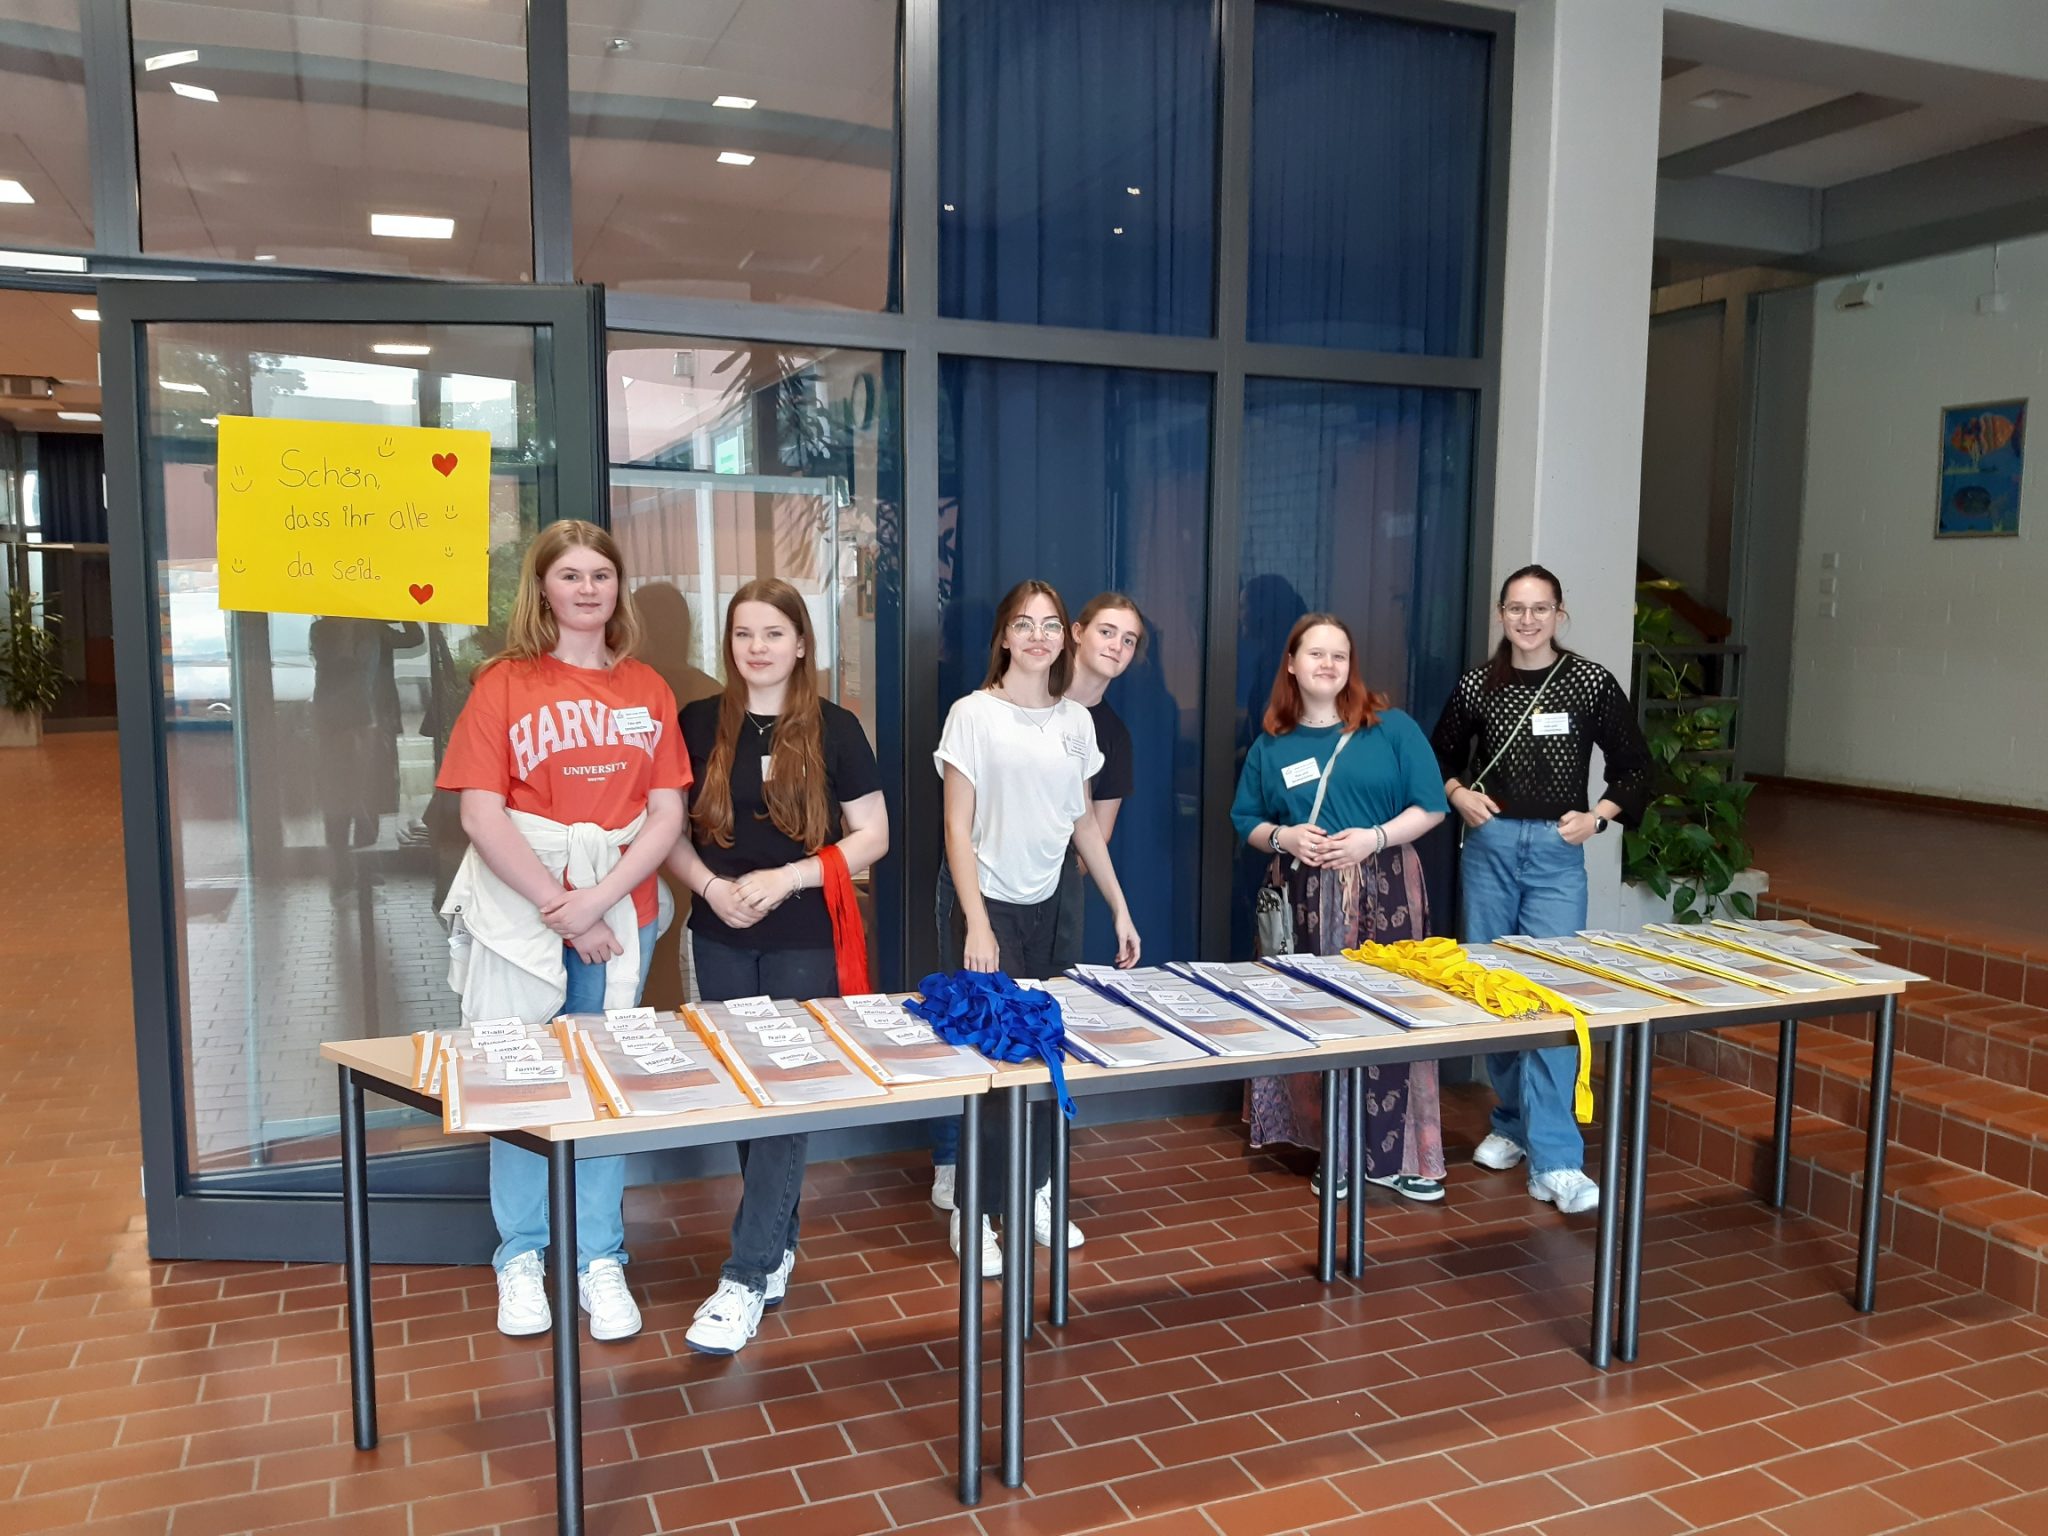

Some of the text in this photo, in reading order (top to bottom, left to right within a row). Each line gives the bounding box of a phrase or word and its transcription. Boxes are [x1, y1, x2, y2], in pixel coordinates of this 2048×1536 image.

[278, 449, 380, 490] Schön,
[284, 502, 429, 531] dass ihr alle
[287, 551, 381, 581] da seid.
[562, 761, 628, 776] UNIVERSITY
